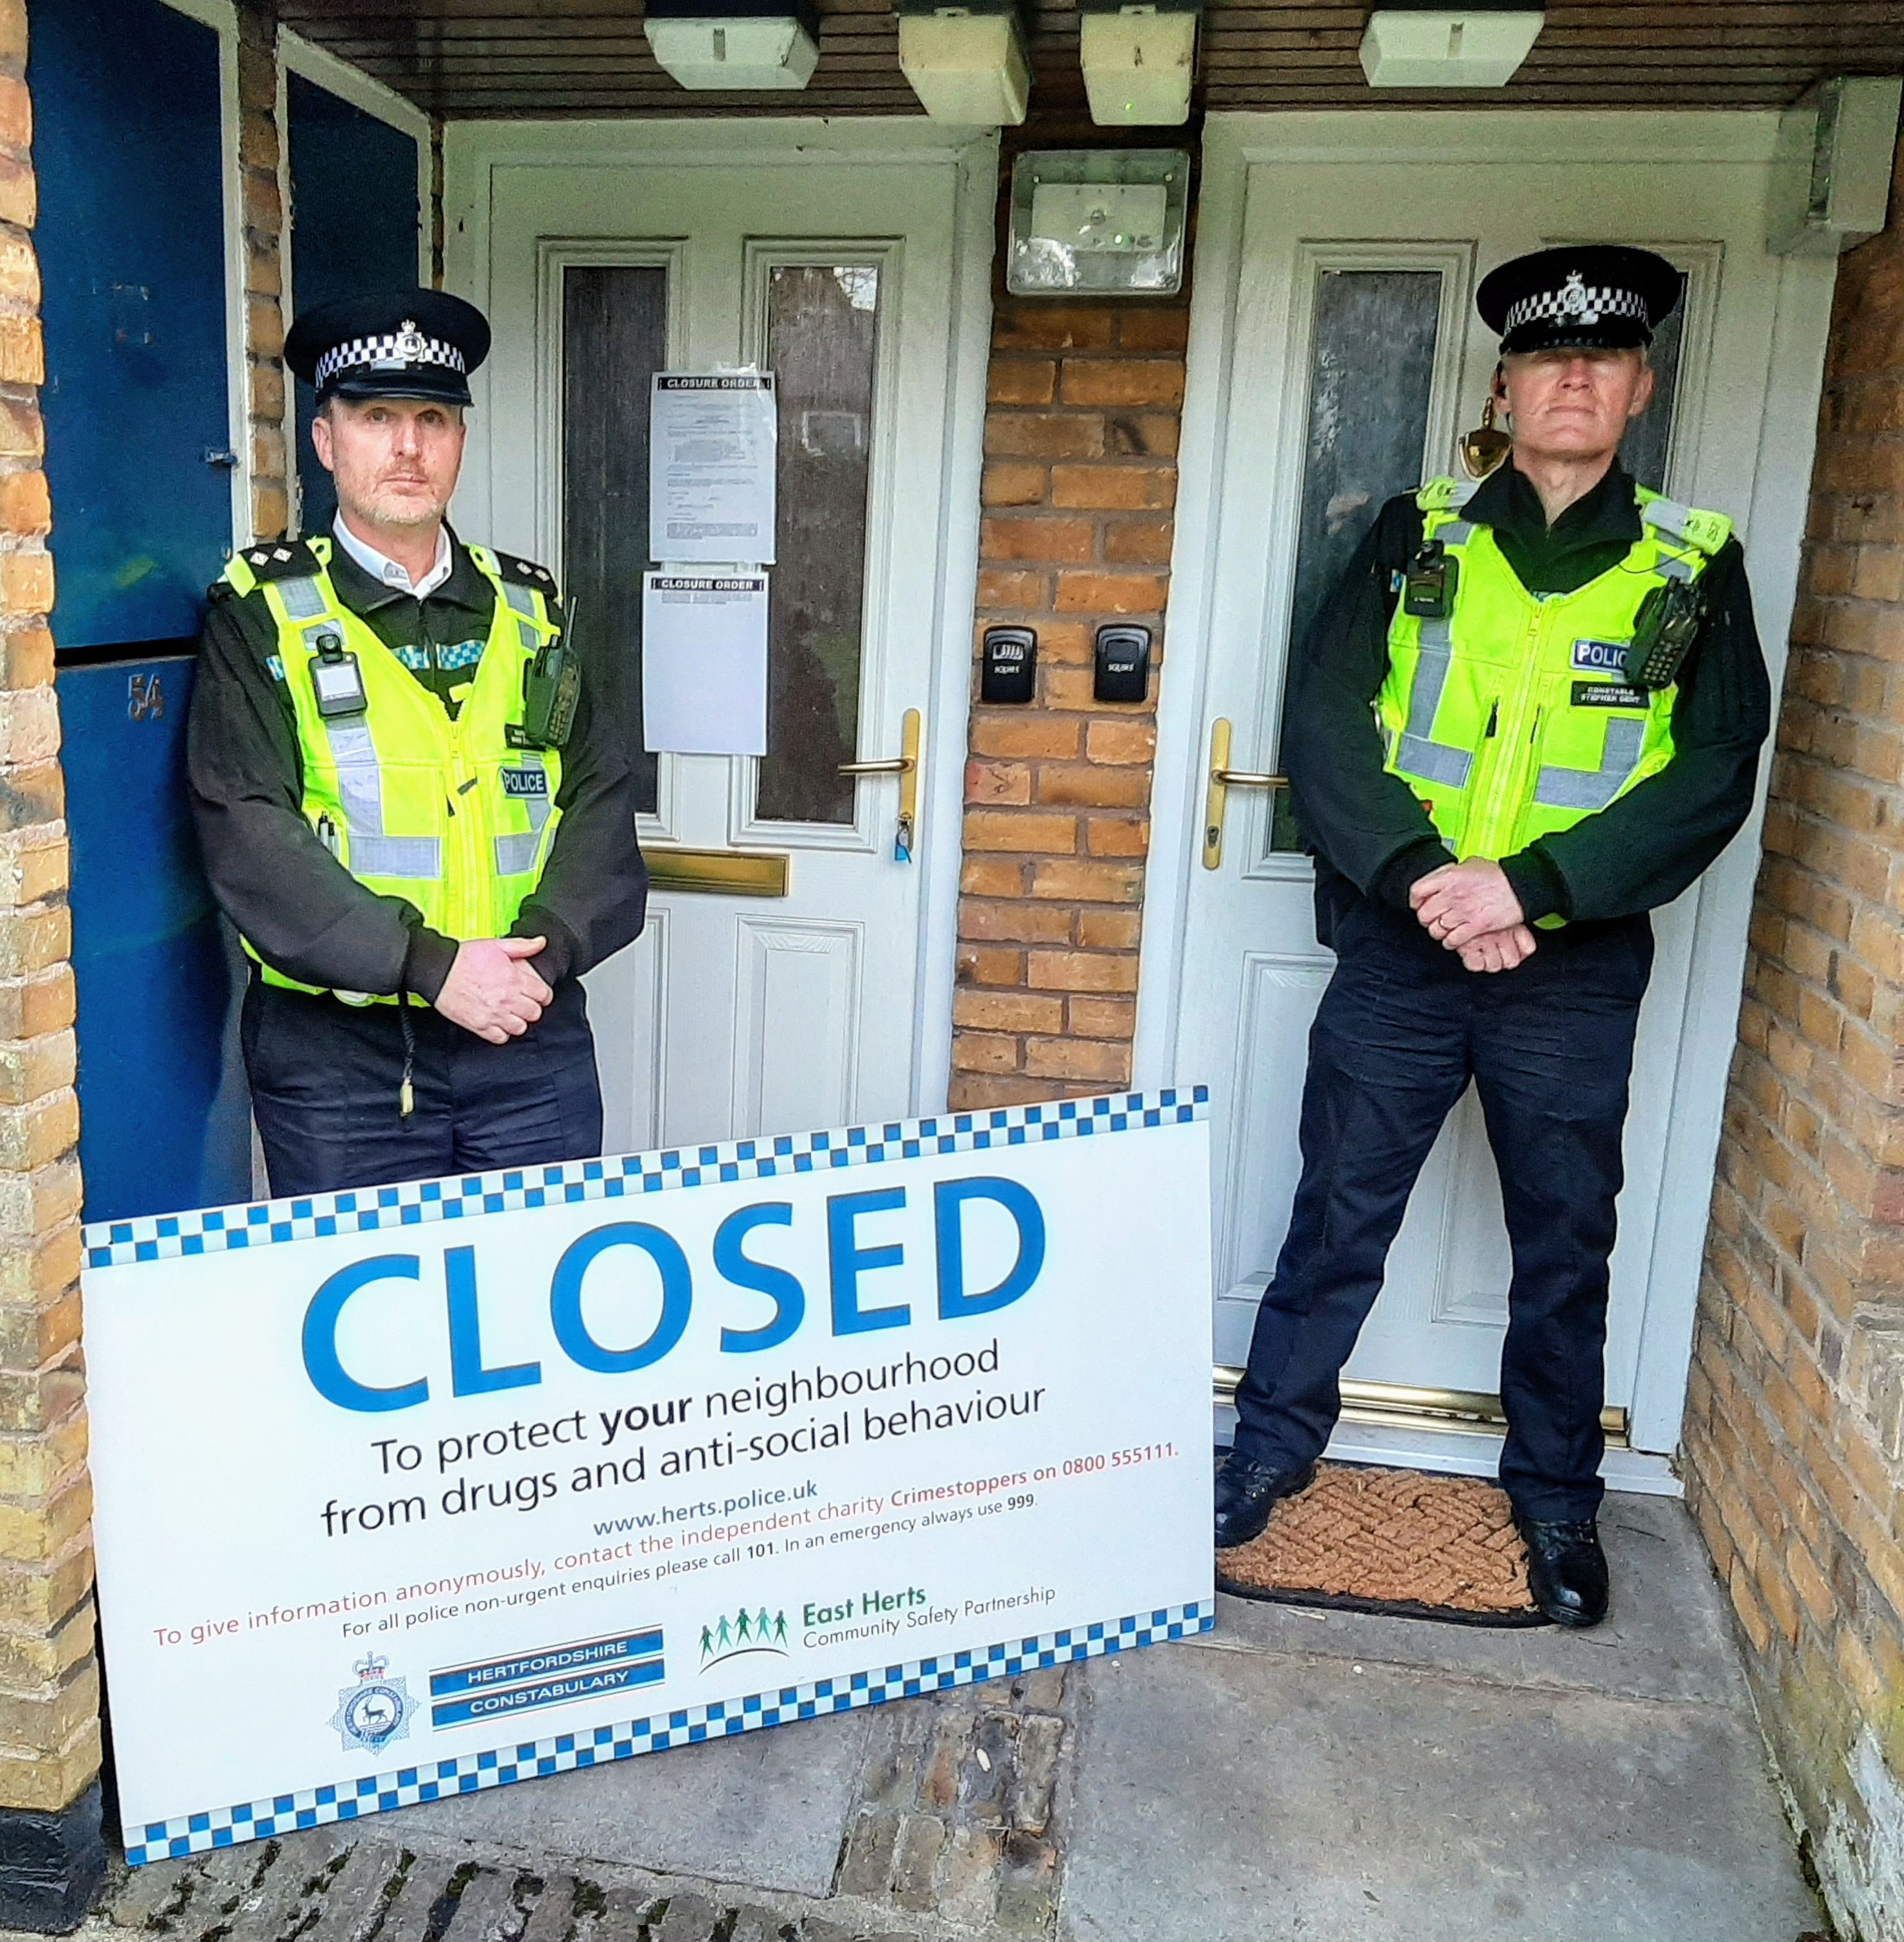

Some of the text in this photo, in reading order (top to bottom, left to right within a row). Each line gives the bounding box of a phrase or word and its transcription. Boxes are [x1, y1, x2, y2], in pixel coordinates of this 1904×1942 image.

[667, 378, 718, 389] CLOSURE
[661, 579, 754, 590] CLOSURE ORDER
[1577, 643, 1628, 668] POLIC
[504, 773, 545, 792] POLICE
[301, 1175, 1046, 1413] CLOSED
[371, 1338, 998, 1474] To protect your neighbourhood
[320, 1388, 1045, 1537] from drugs and anti-social behaviour
[593, 1479, 817, 1536] www.herts.police.uk
[153, 1442, 1179, 1646] To give information anonymously, contact the independent charity Crimestoppers on 0800 555111.
[343, 1622, 371, 1638] For
[379, 1613, 398, 1631] all
[406, 1605, 459, 1629] police
[465, 1583, 566, 1614] non-urgent
[656, 1558, 707, 1580] please
[714, 1547, 740, 1565] call
[747, 1542, 779, 1559] 101.
[786, 1539, 799, 1552] In
[805, 1536, 824, 1548] an
[830, 1519, 916, 1543] emergency
[922, 1508, 973, 1527] always
[978, 1503, 1002, 1516] use
[1008, 1494, 1037, 1510] 999.
[803, 1587, 925, 1627] East Herts
[804, 1586, 1055, 1648] Community Safety Partnership
[467, 1640, 628, 1684] HERTFORDSHIRE
[469, 1670, 629, 1714] CONSTABULARY
